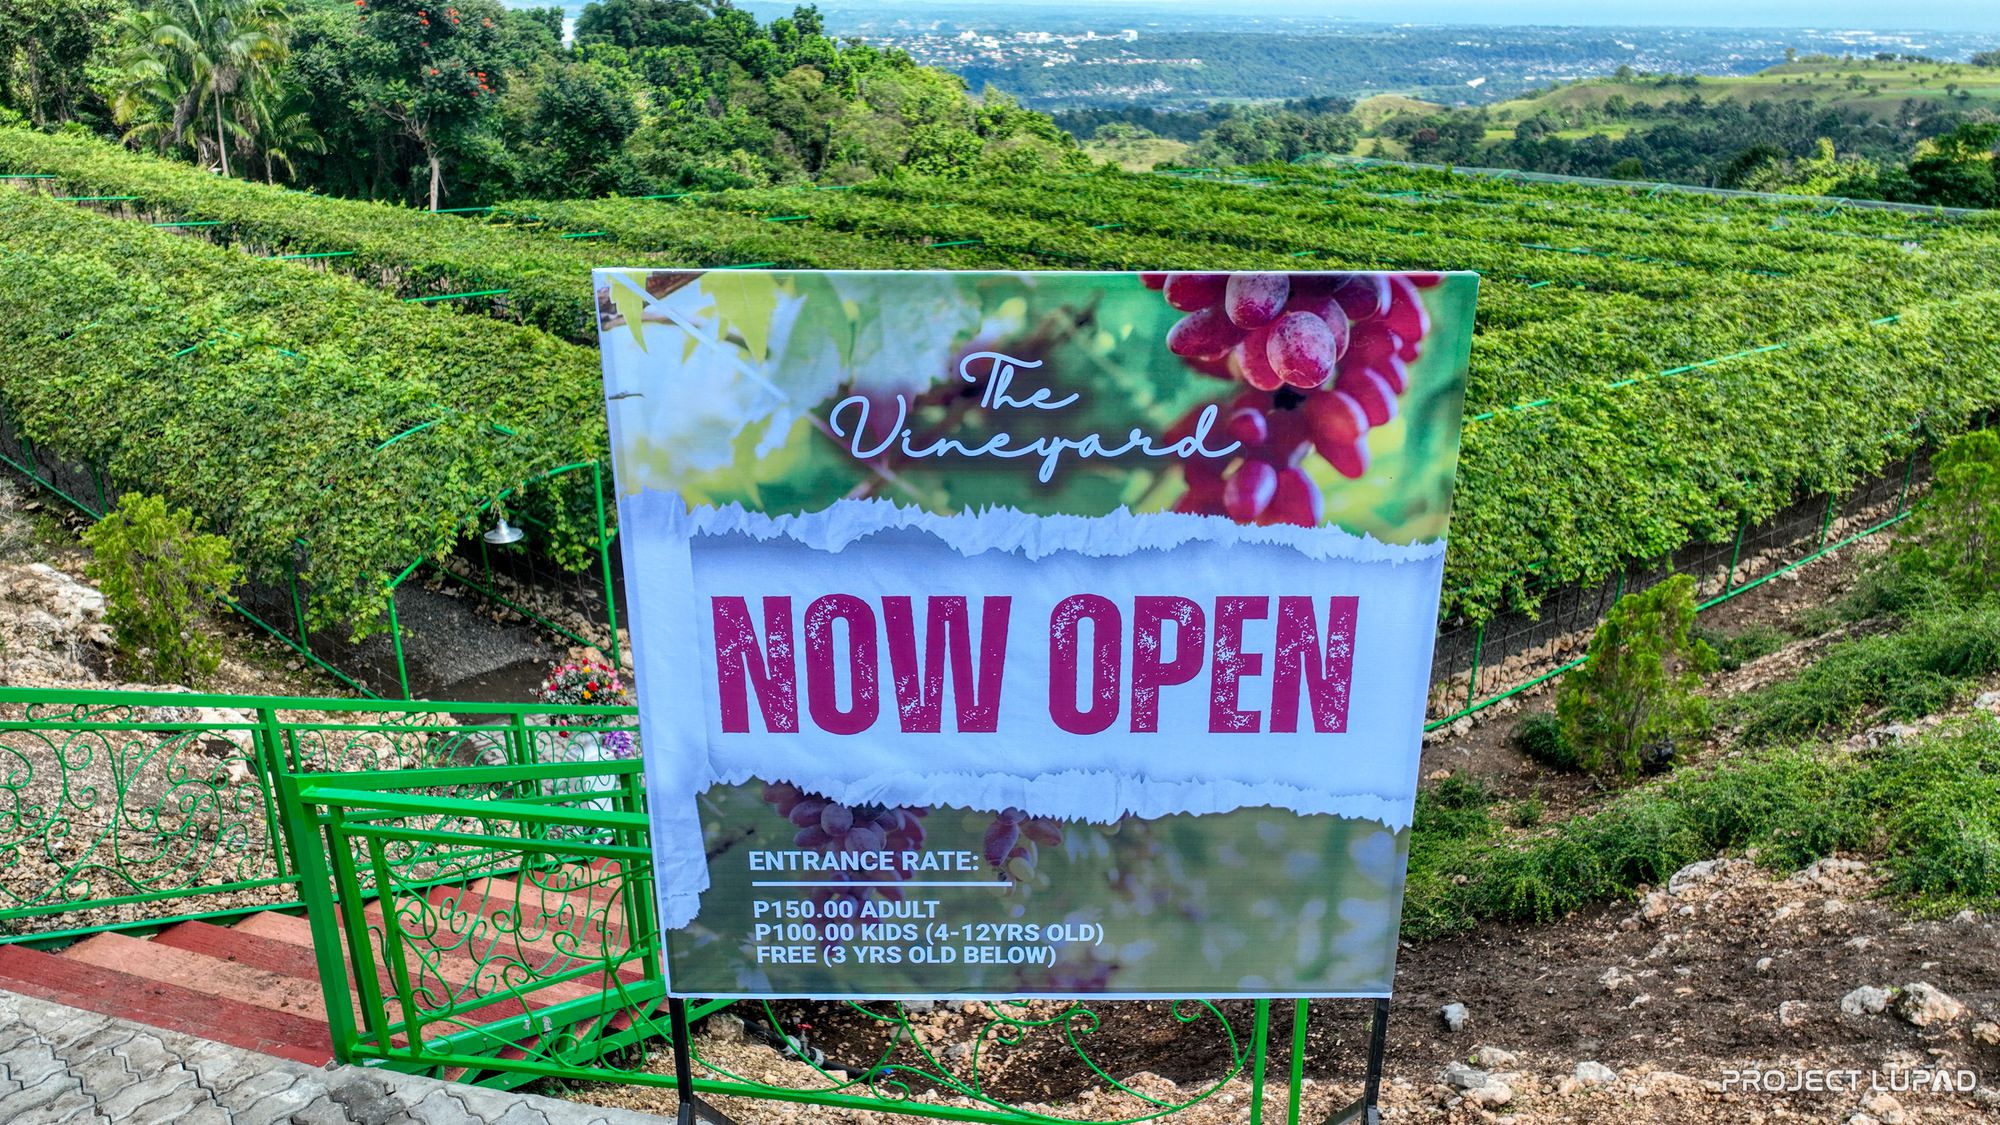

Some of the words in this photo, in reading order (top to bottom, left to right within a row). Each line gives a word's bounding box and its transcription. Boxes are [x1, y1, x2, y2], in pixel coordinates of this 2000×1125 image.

[959, 351, 1080, 410] The
[829, 394, 1242, 483] Vineyard
[711, 593, 1012, 736] NOW
[1049, 593, 1360, 736] OPEN
[748, 850, 895, 871] ENTRANCE
[902, 850, 980, 871] RATE:
[753, 900, 854, 919] P150.00
[860, 900, 940, 919] ADULT
[755, 923, 855, 942] P100.00
[861, 923, 918, 942] KIDS
[925, 922, 1040, 946] (4-12YRS
[1046, 922, 1104, 946] OLD)
[756, 946, 816, 964] FREE
[823, 945, 846, 968] (3
[853, 946, 902, 964] YRS
[908, 946, 957, 964] OLD
[963, 945, 1057, 968] BELOW)
